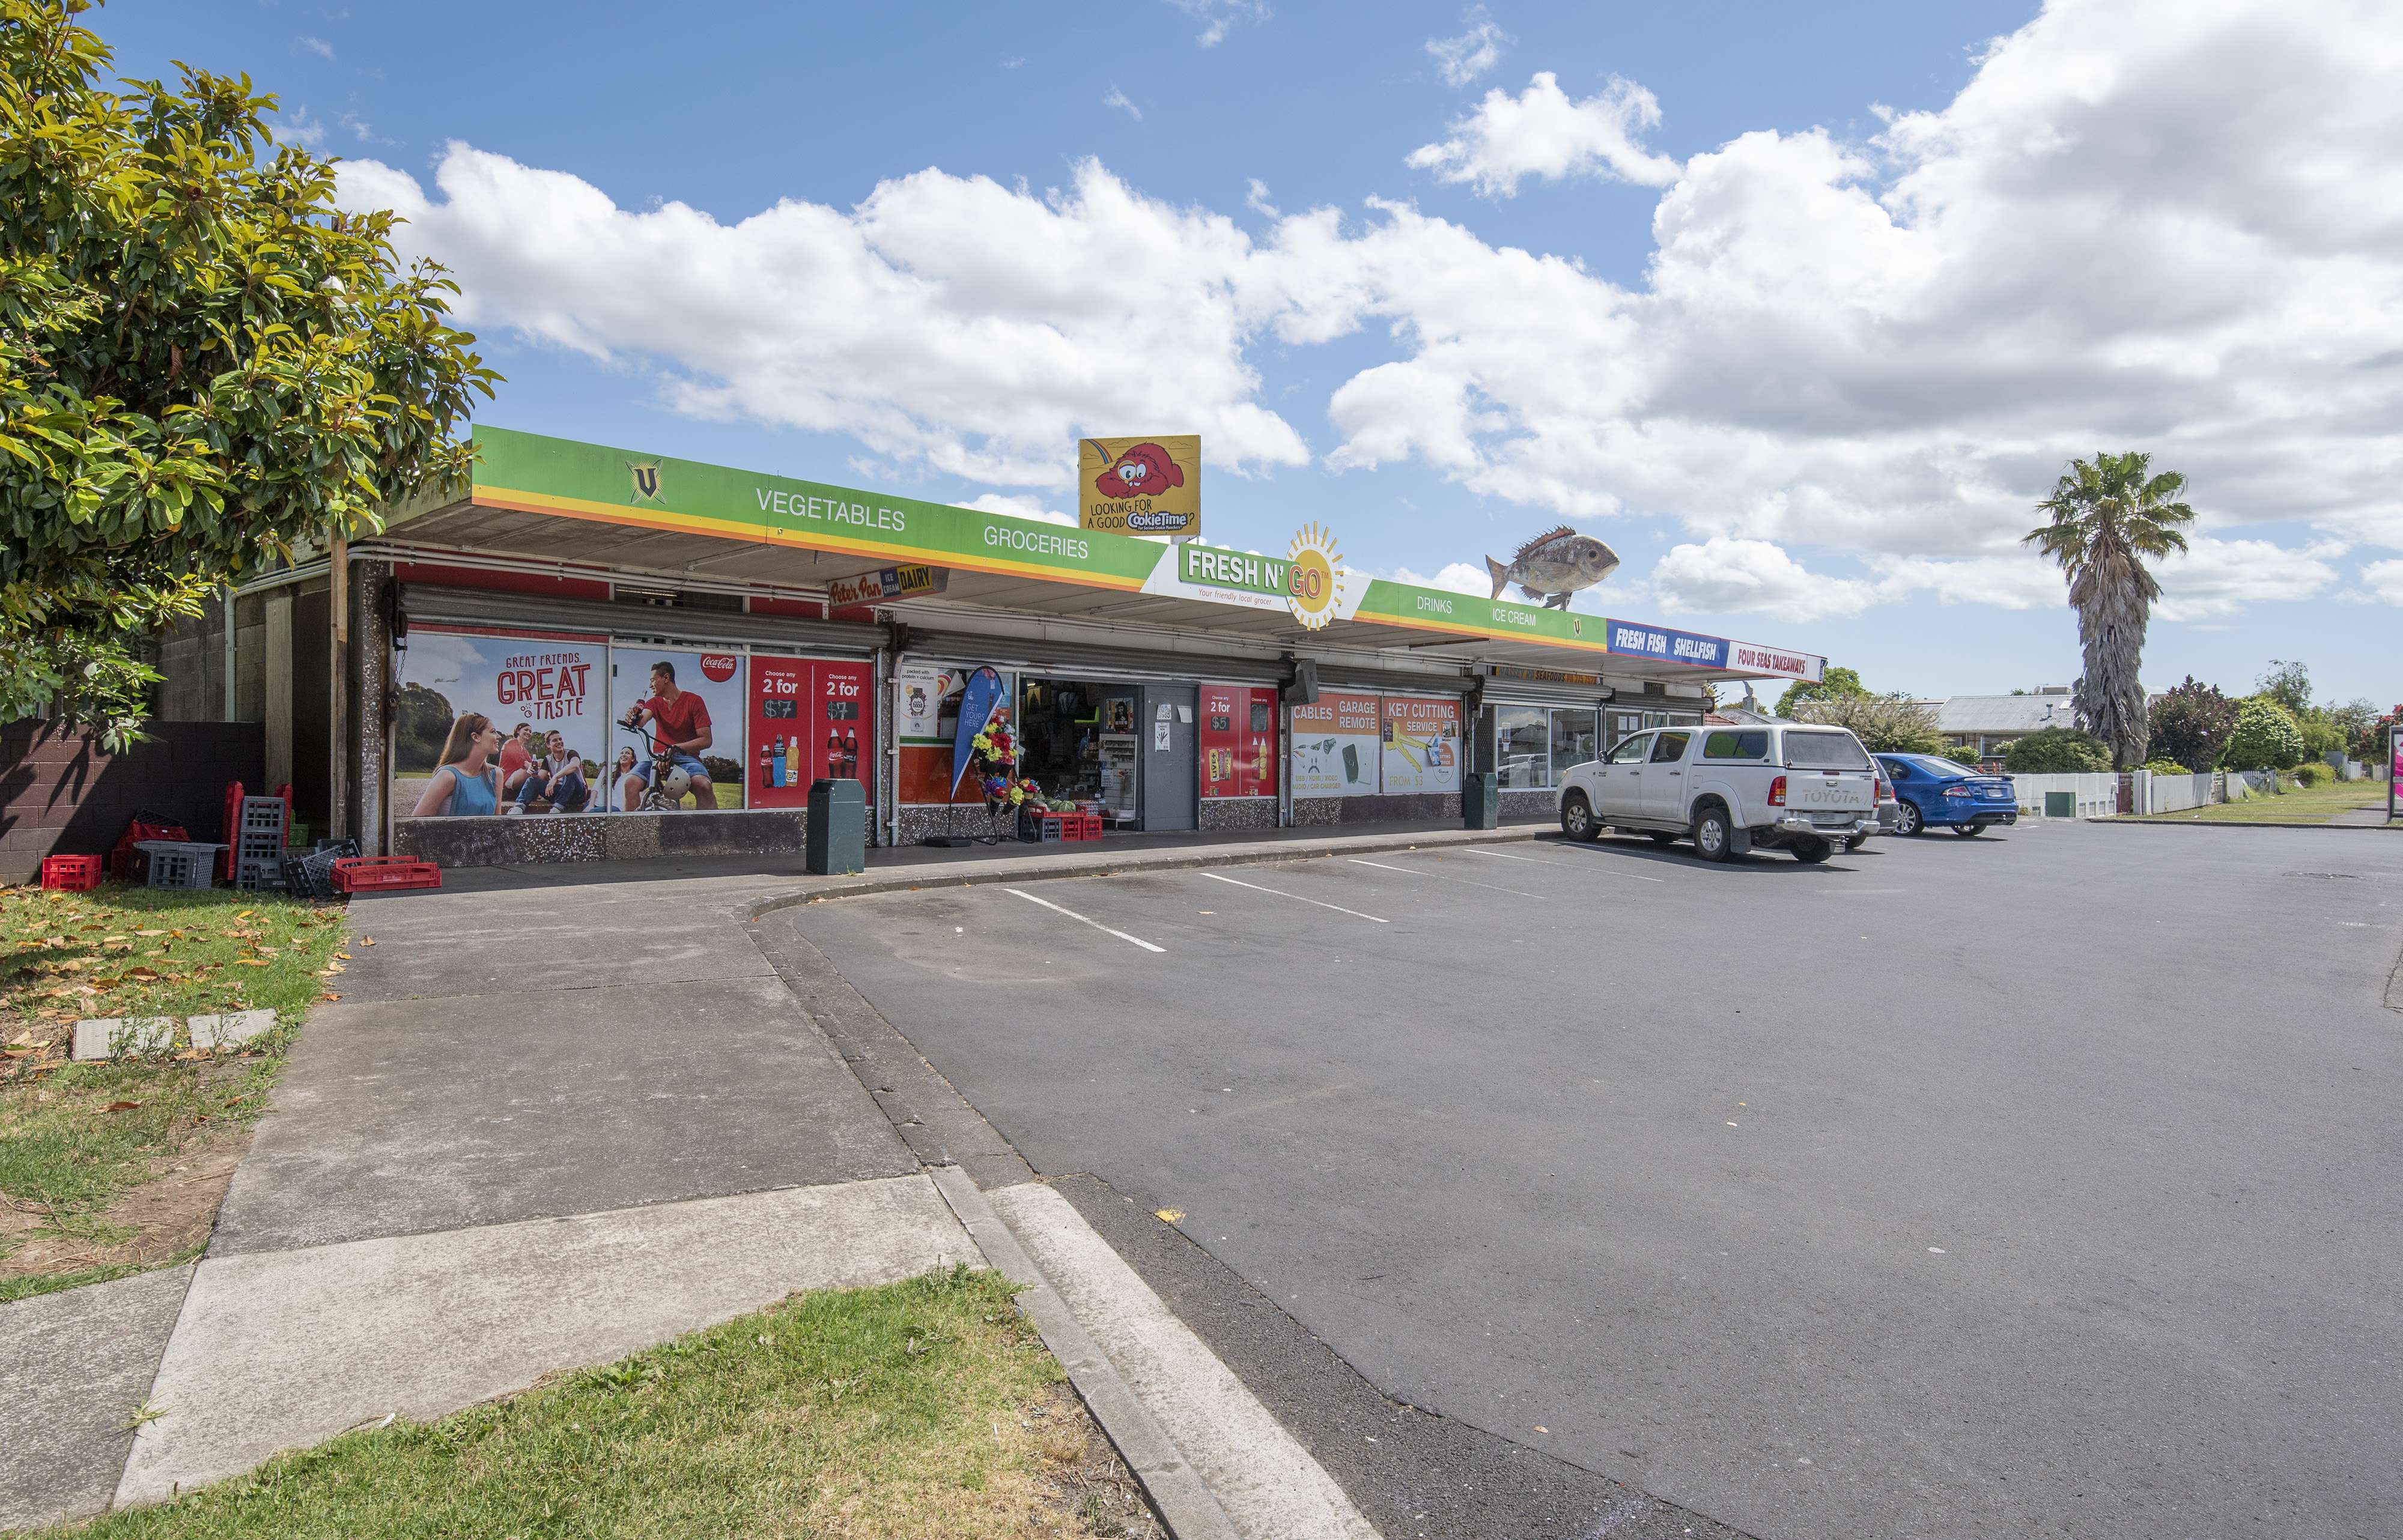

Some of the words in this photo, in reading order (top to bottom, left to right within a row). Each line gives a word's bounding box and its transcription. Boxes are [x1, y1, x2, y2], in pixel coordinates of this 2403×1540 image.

[756, 488, 905, 532] VEGETABLES
[1090, 501, 1132, 516] LOOKING
[1135, 499, 1152, 511] FOR
[1088, 517, 1094, 529] A
[1097, 517, 1125, 529] GOOD
[1128, 512, 1187, 528] CookieTime
[984, 526, 1088, 559] GROCERIES
[885, 574, 893, 582] ICE
[899, 566, 931, 590] DAIRY
[1188, 549, 1258, 586] FRESH
[1265, 562, 1284, 589] N'
[1288, 565, 1322, 599] GO
[830, 581, 859, 605] Peter
[858, 576, 882, 598] Pan
[883, 583, 900, 594] CREAM
[1198, 588, 1212, 597] Your
[1215, 590, 1237, 602] friendly
[1239, 594, 1252, 602] local
[1254, 598, 1272, 606] grocer
[1417, 596, 1452, 614] DRINKS
[1493, 608, 1505, 622] ICE
[1508, 610, 1536, 626] CREAM
[1615, 628, 1646, 650] FRESH
[1647, 633, 1667, 653] FISH
[1673, 637, 1717, 661] SHELLFISH
[506, 655, 536, 668] GREAT
[540, 652, 582, 666] FRIENDS.
[1737, 649, 1755, 667] FOUR
[1756, 651, 1772, 669] SEAS
[1772, 654, 1806, 674] TAKEAWAYS
[1536, 670, 1566, 682] SEAFOODS
[497, 664, 591, 705] GREAT
[762, 679, 773, 693] 2
[776, 679, 798, 694] for
[826, 682, 836, 696] 2
[839, 682, 859, 696] for
[533, 697, 583, 720] TASTE
[967, 703, 979, 712] GET
[1211, 702, 1217, 712] 2
[1218, 701, 1230, 712] for
[1293, 706, 1332, 720] CABLES
[1339, 700, 1376, 714] GARAGE
[1388, 703, 1409, 717] KEY
[1412, 703, 1454, 719] CUTTING
[964, 718, 980, 728] HERE
[966, 711, 985, 721] YOURS
[1212, 716, 1226, 730] $5
[1339, 717, 1376, 729] REMOTE
[1407, 721, 1438, 732] SERVICE
[1389, 776, 1411, 786] FROM
[1802, 790, 1859, 804] TOYOTA
